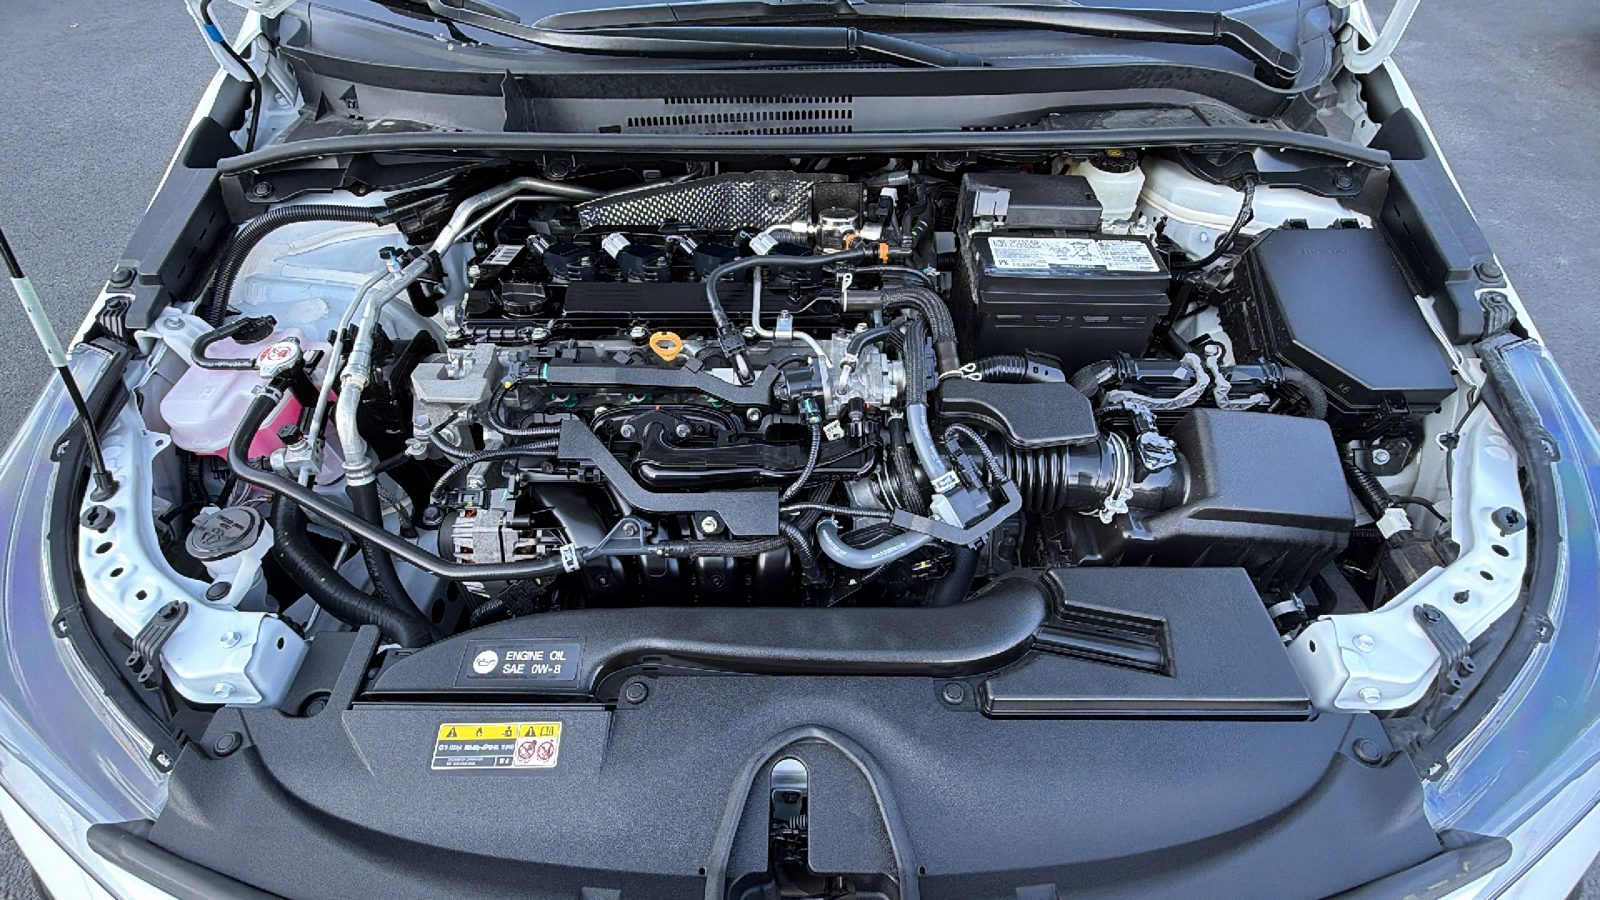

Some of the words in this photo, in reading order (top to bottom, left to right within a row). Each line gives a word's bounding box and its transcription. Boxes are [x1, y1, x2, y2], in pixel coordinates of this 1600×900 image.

[505, 651, 544, 661] ENGINE
[549, 650, 567, 661] OIL
[502, 663, 525, 674] SAE
[531, 664, 561, 674] 0W-8
